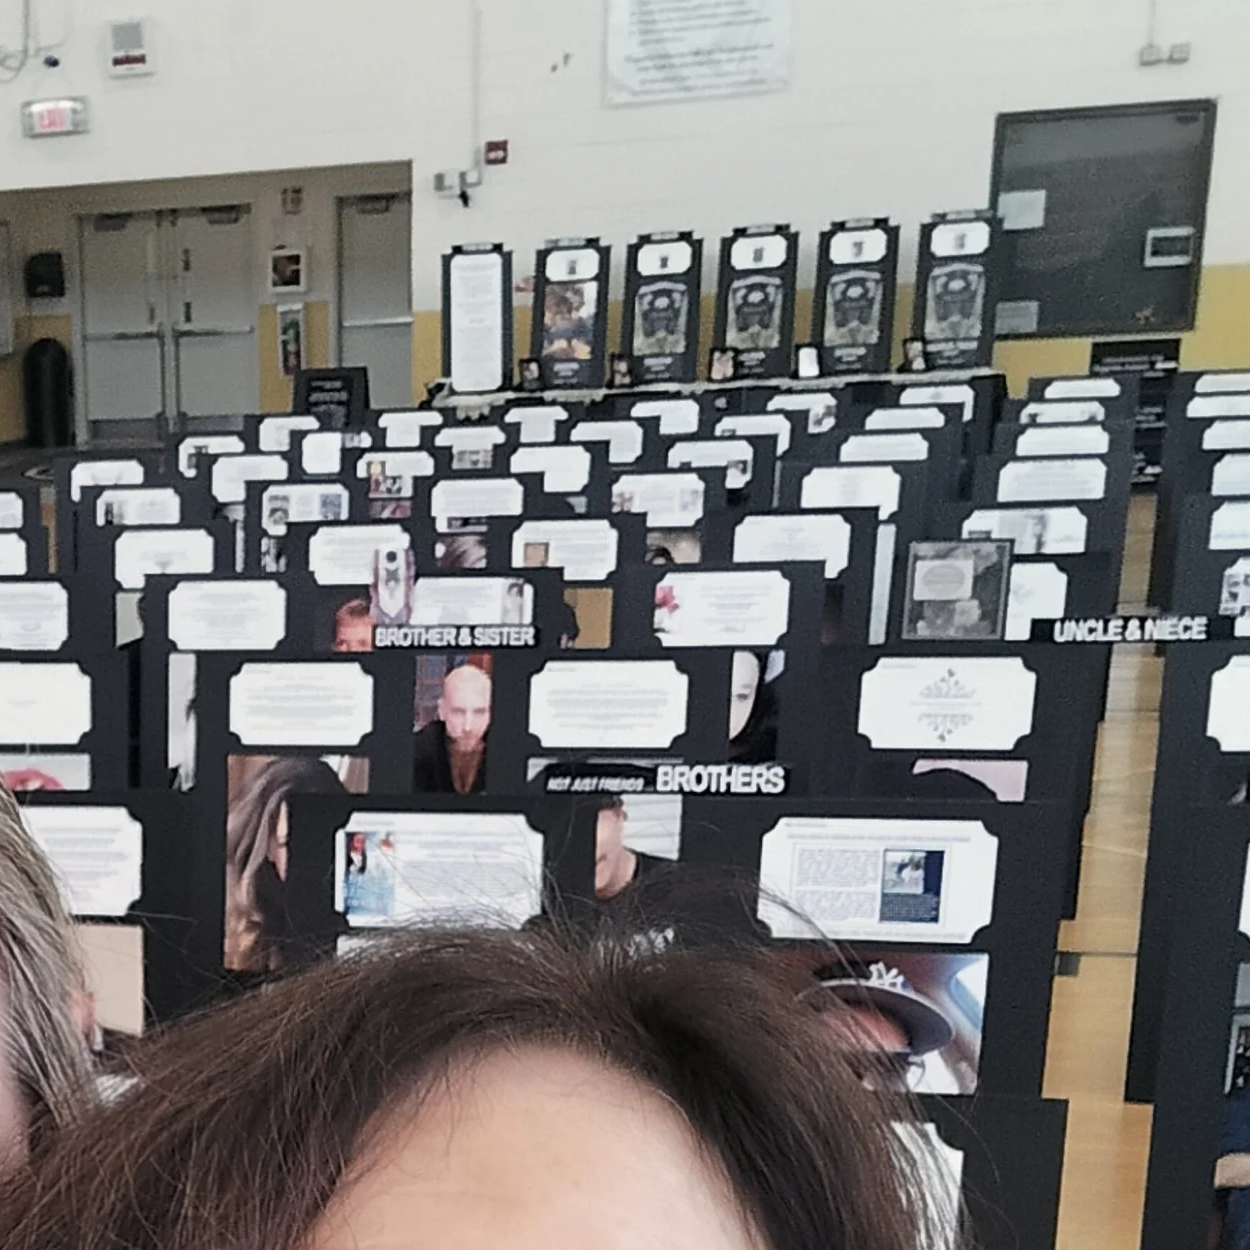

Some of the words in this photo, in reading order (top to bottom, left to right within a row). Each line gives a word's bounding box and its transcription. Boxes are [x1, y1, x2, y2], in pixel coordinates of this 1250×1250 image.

[374, 627, 457, 647] BROTHER
[458, 627, 472, 647] &
[474, 626, 535, 646] SISTER
[1053, 618, 1123, 642] UNCLE
[1125, 618, 1141, 641] &
[1144, 616, 1208, 641] NIECE
[656, 765, 786, 794] BROTHERS
